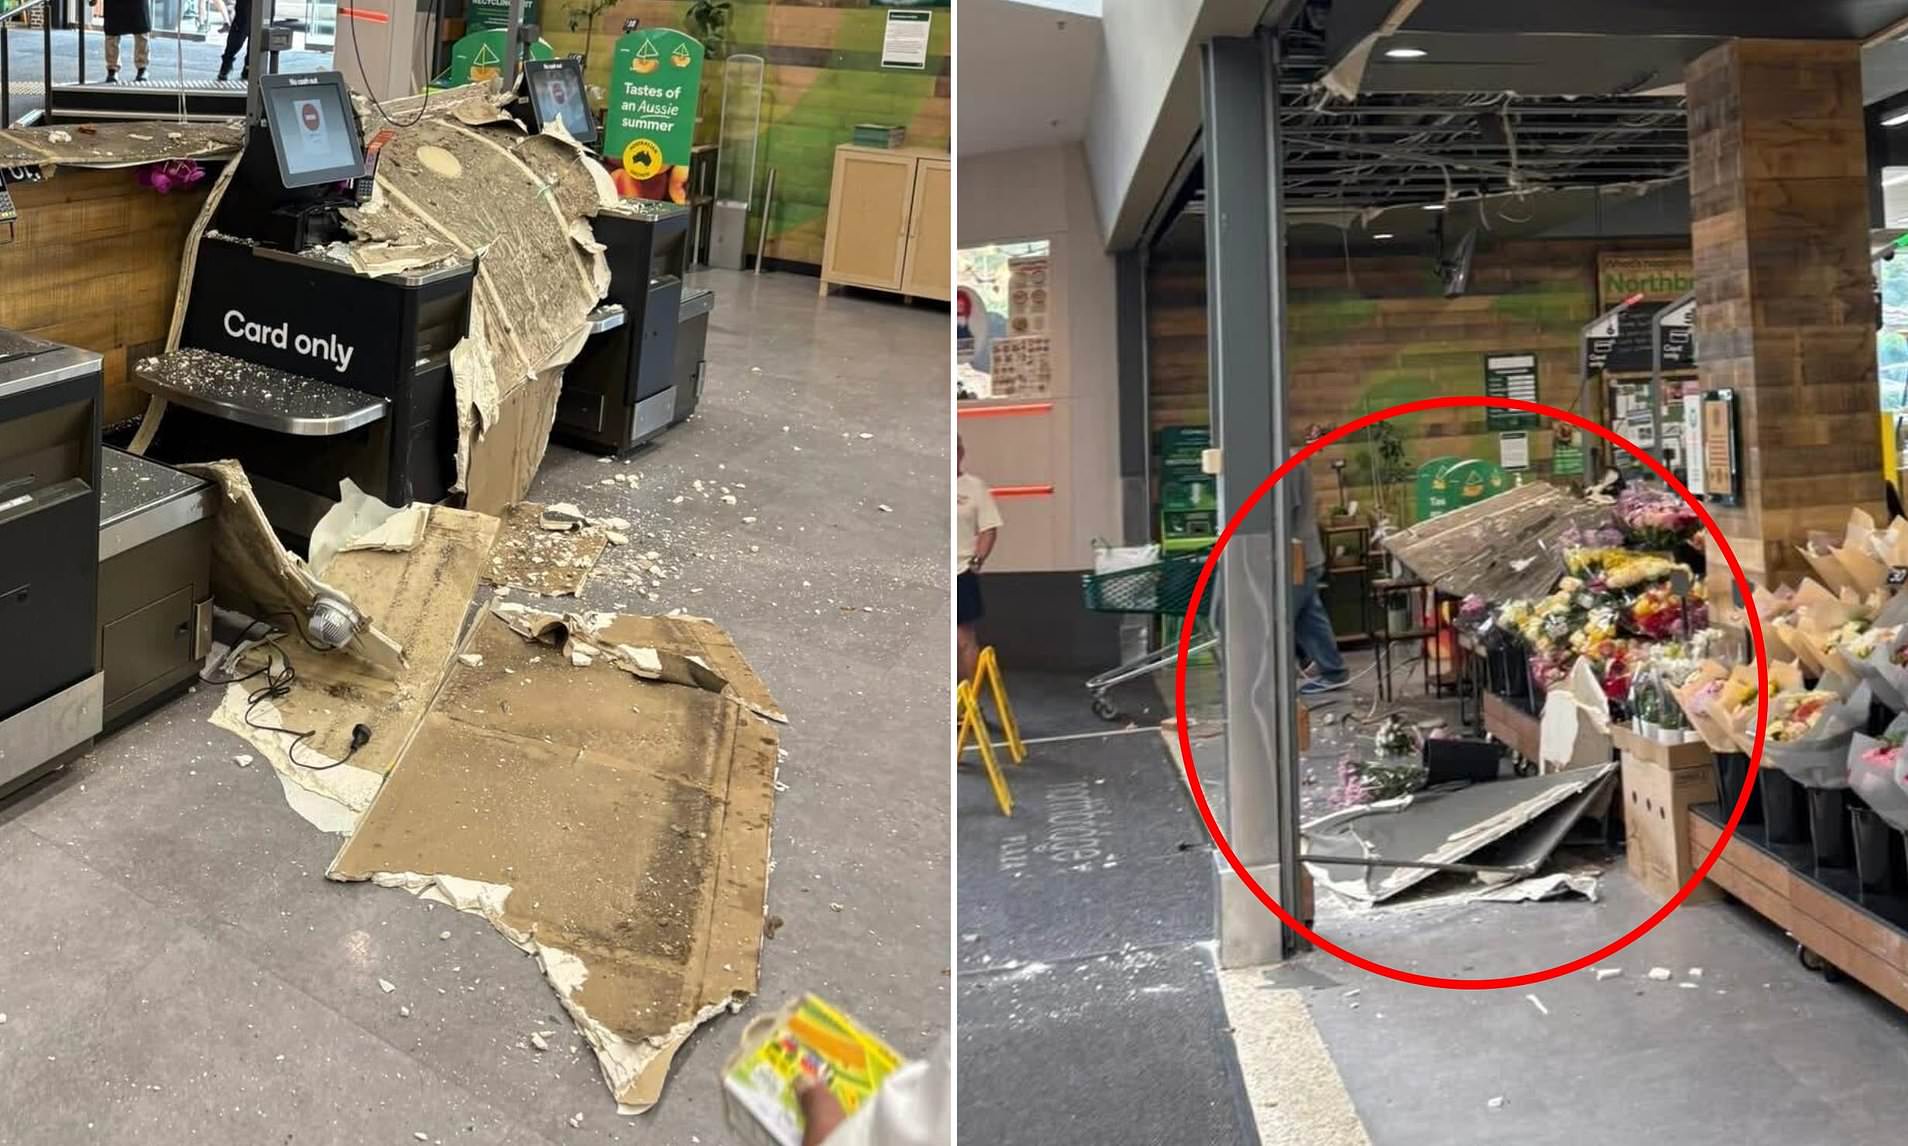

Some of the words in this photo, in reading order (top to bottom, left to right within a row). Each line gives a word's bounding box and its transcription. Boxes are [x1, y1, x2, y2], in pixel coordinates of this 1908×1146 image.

[624, 82, 663, 98] Tastes
[665, 86, 682, 99] of
[621, 101, 636, 111] an
[637, 100, 679, 116] Aussie
[622, 117, 674, 132] summer
[224, 309, 288, 350] Card
[294, 333, 354, 373] only
